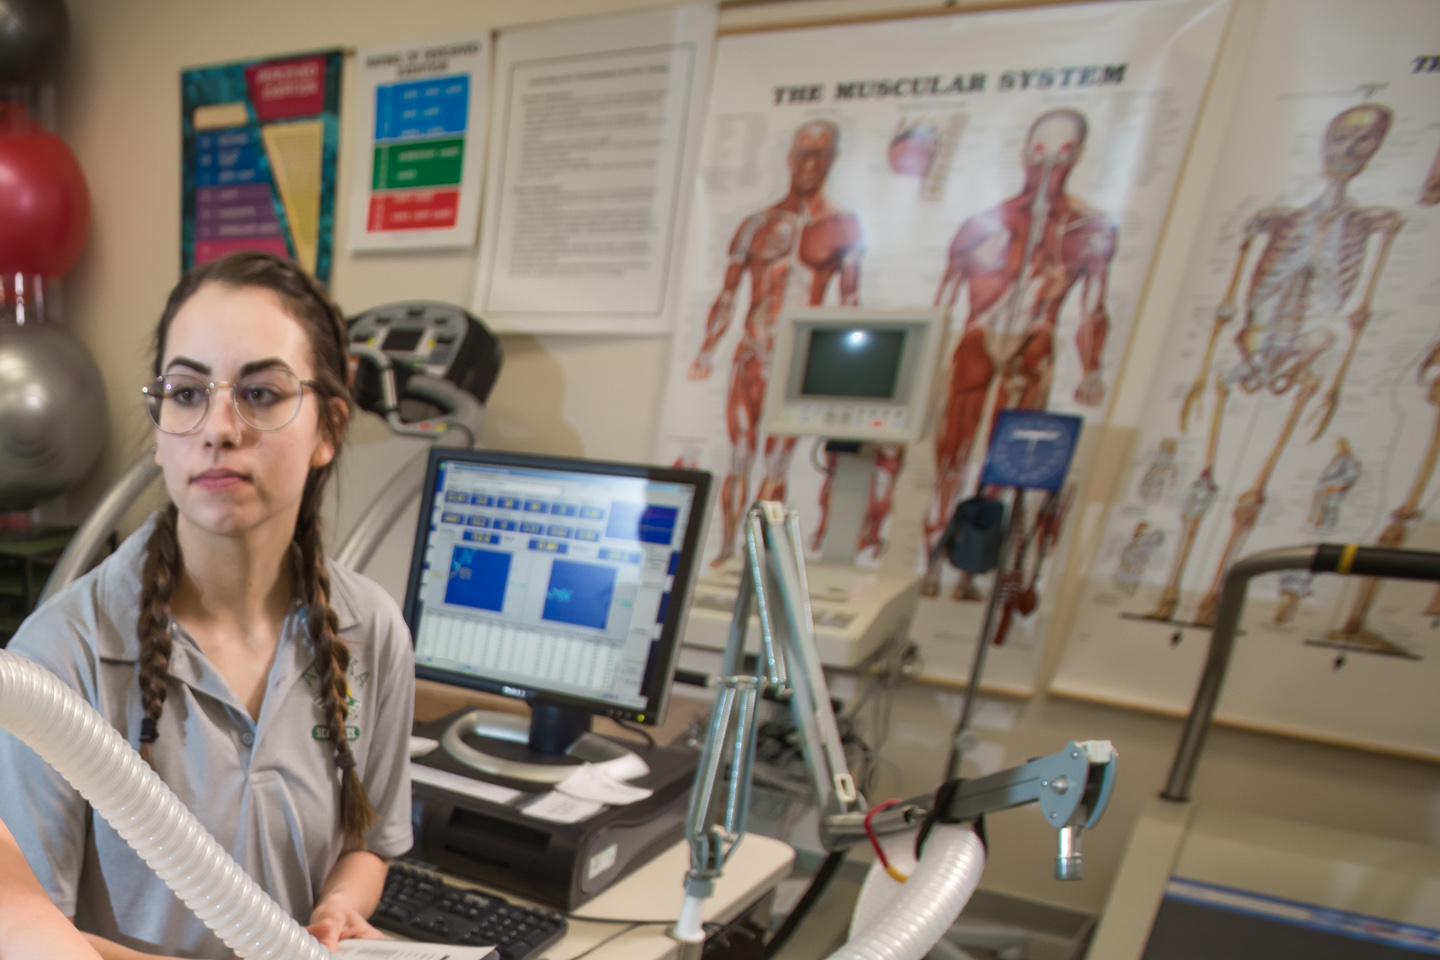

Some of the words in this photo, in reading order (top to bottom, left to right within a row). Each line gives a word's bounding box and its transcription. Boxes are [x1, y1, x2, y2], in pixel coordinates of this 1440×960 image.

[774, 84, 825, 105] THE
[835, 73, 987, 100] MUSCULAR
[999, 63, 1128, 91] SYSTEM
